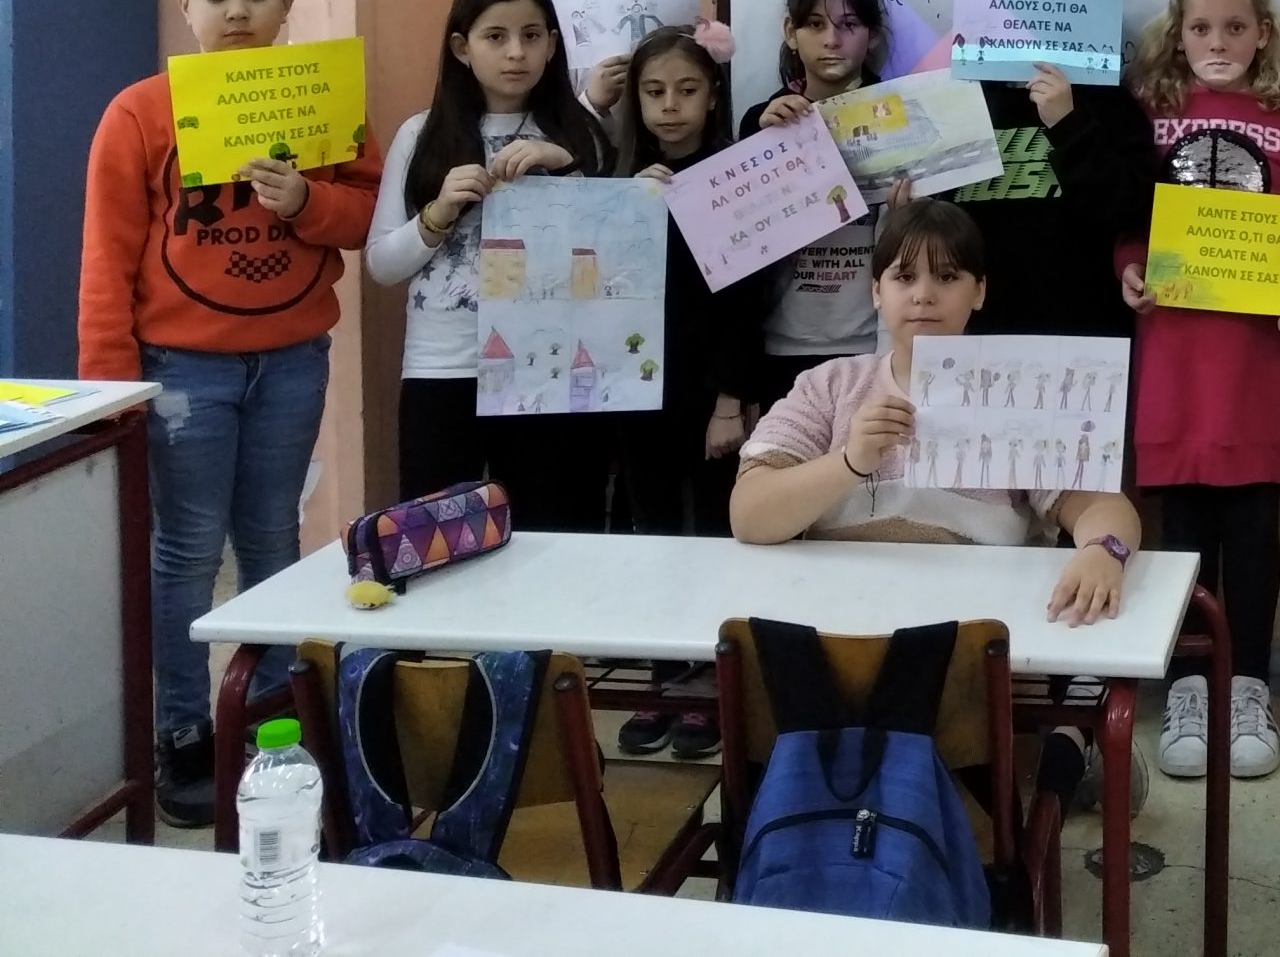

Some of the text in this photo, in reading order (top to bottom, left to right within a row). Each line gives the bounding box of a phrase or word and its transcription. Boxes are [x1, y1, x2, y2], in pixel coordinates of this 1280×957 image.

[989, 0, 1088, 14] ΑΛΛΟΥΣ Ο,ΤΙ ΘΑ
[1003, 19, 1072, 32] ΘΕΛΑΤΕ ΝΑ
[989, 38, 1084, 52] ΚΑΝΟΥΝ ΣΕ ΣΑΣ
[225, 63, 320, 83] ΚΑΝΤΕ ΣΤΟΥΣ
[217, 82, 330, 105] ΑΛΛΟΥΣ Ο,ΤΙ ΘΑ
[237, 105, 316, 125] ΘΕΛΑΤΕ ΝΑ
[224, 123, 330, 148] ΚΑΝΟΥΝ ΣΕ ΣΑΣ
[1197, 206, 1278, 225] ΚΑΝΤΕ ΣΤΟΥΣ
[196, 226, 260, 245] PROD
[1186, 225, 1236, 240] ΑΛΛΟΥΣ
[1239, 231, 1263, 244] Ο,ΤΙ
[801, 245, 875, 256] VERY MOMENT
[1199, 245, 1268, 263] ΘΕΛΑΤΕ ΝΑ
[812, 259, 839, 268] WITH
[844, 259, 865, 268] ALL
[817, 271, 857, 281] HEART
[1184, 264, 1279, 284] ΚΑΝΟΥΝ ΣΕ ΣΑΣ
